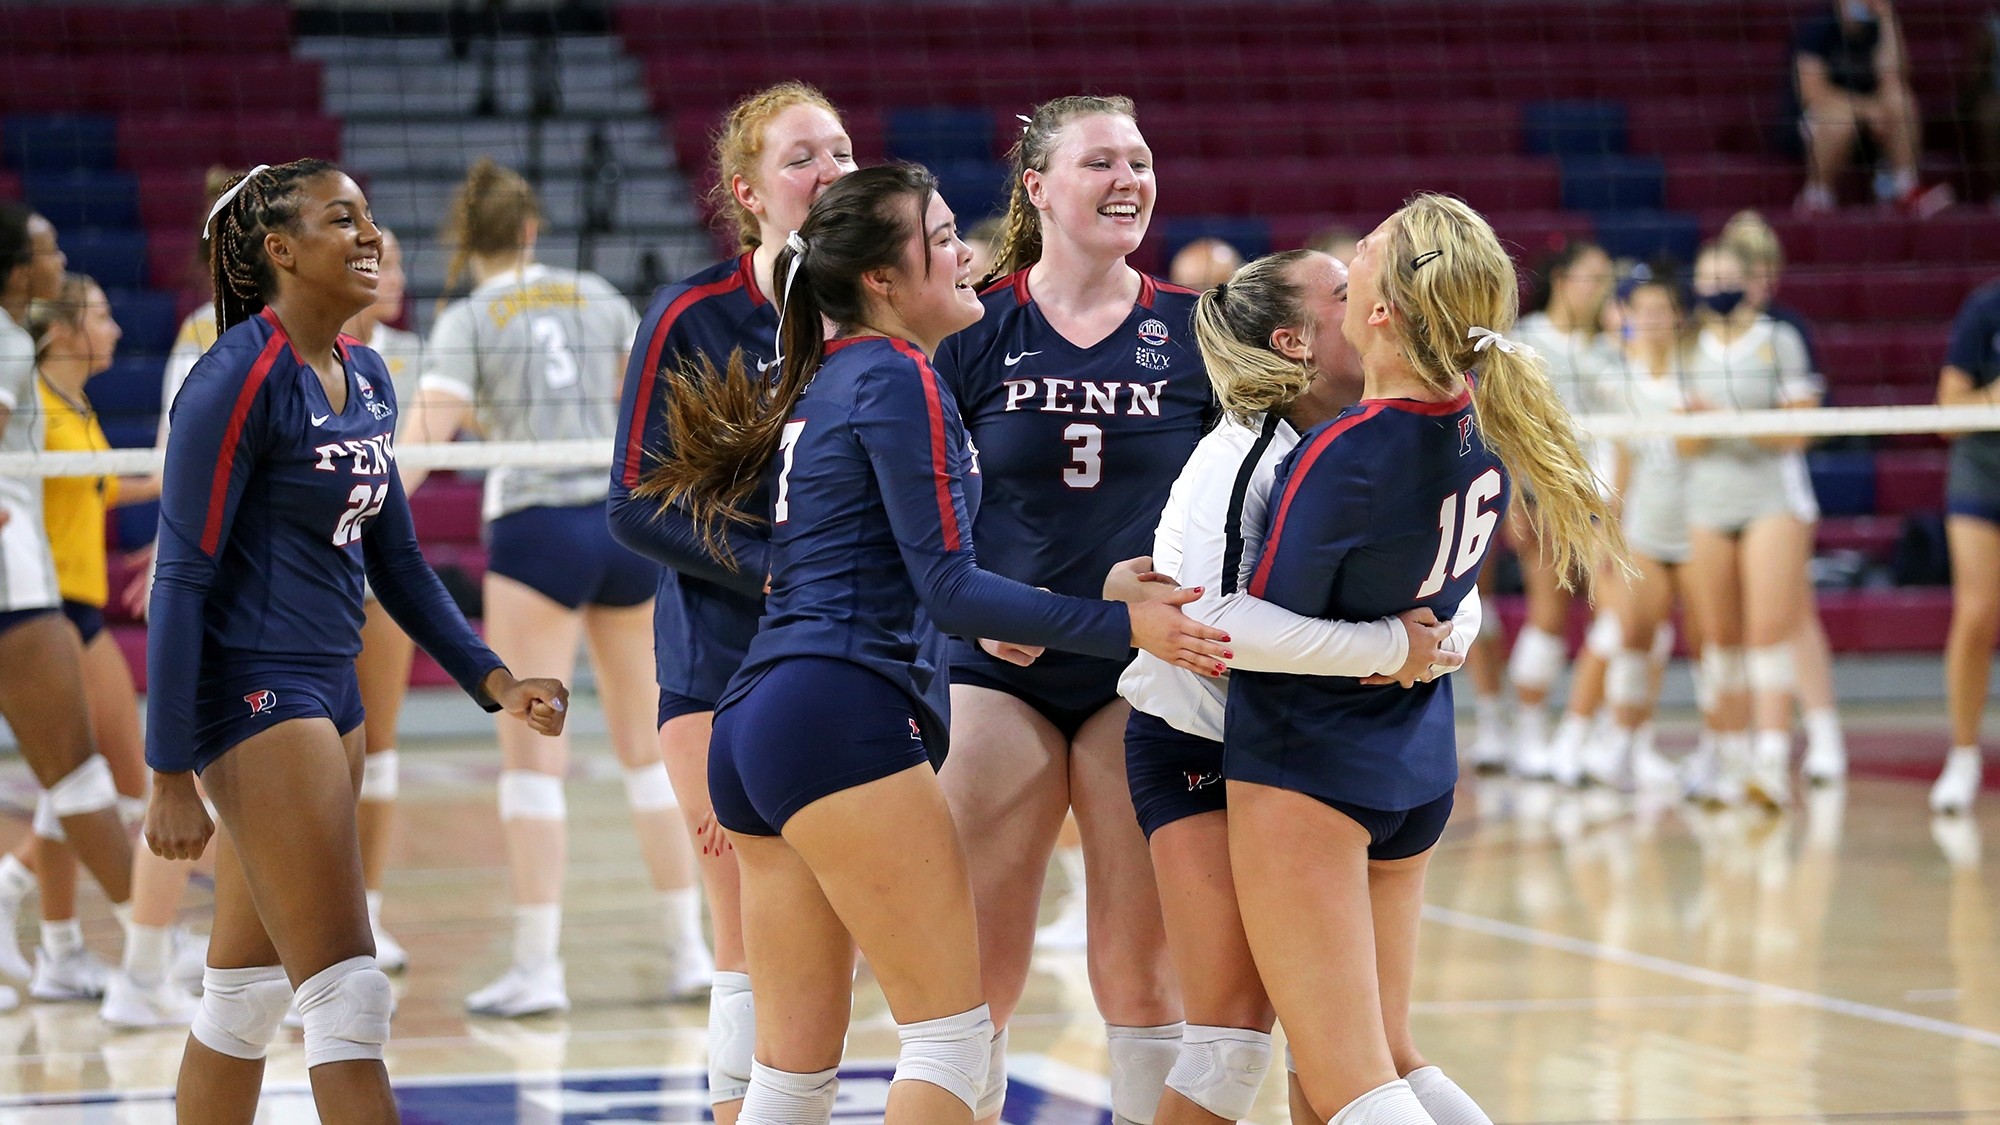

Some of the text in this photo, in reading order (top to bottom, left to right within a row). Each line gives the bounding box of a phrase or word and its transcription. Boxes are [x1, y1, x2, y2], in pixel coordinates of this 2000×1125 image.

[536, 315, 579, 389] 3
[1145, 352, 1170, 366] IVY
[1003, 377, 1169, 416] PENN
[775, 418, 807, 525] 7
[1062, 421, 1104, 490] 3
[332, 482, 389, 548] 22
[1414, 465, 1502, 600] 16
